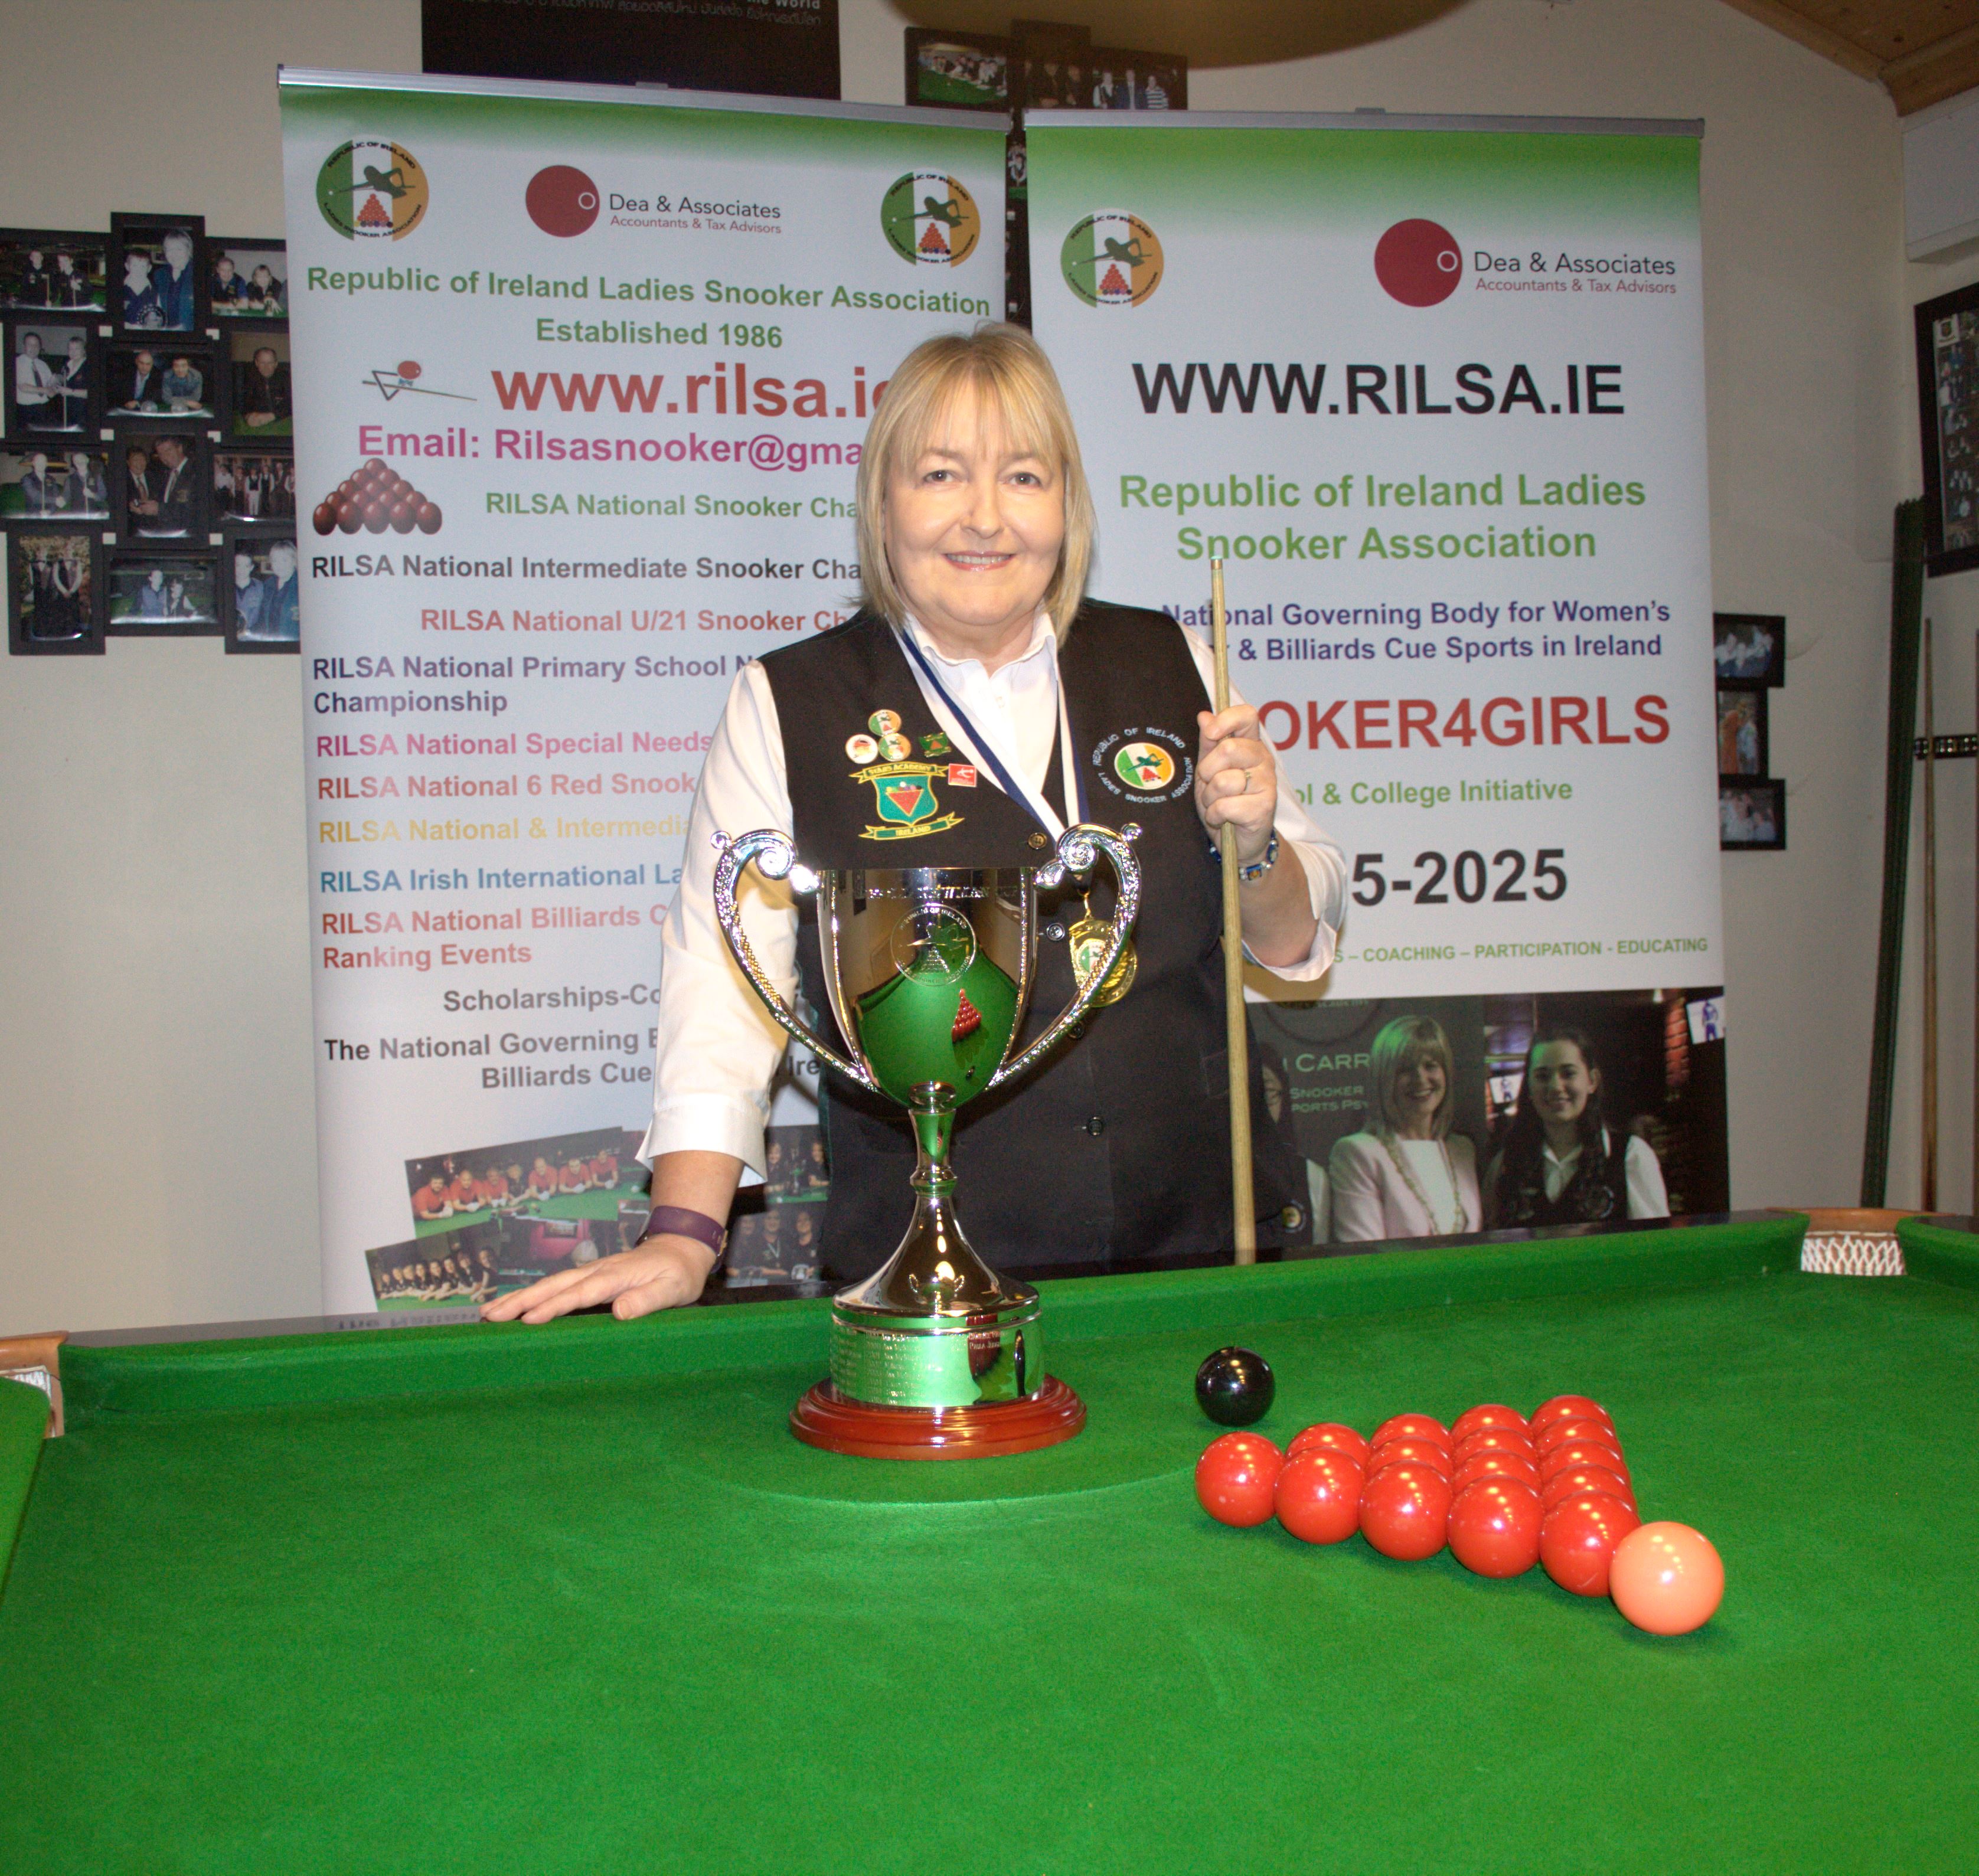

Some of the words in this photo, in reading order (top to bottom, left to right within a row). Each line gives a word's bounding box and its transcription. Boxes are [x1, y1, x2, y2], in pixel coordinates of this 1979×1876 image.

[328, 142, 365, 168] REPUBLIC
[380, 143, 416, 169] IRELAND
[938, 177, 969, 201] IRELAND
[609, 193, 649, 211] Dea
[657, 195, 671, 212] &
[678, 197, 781, 219] Associates
[383, 204, 422, 237] ASSOCIATION
[610, 215, 688, 228] Accountants
[693, 218, 702, 229] &
[706, 218, 726, 230] Tax
[729, 221, 781, 234] Advisors
[1119, 217, 1152, 238] IRELAND
[1474, 251, 1520, 272] Dea
[1530, 251, 1546, 273] &
[1555, 253, 1676, 276] Associates
[308, 267, 439, 295] Republic
[450, 271, 479, 293] of
[489, 272, 588, 299] Ireland
[600, 276, 694, 302] Ladies
[705, 280, 823, 307] Snooker
[831, 286, 990, 318] Association
[1475, 277, 1567, 292] Accountants
[1571, 279, 1583, 292] &
[1587, 278, 1612, 292] Tax
[1616, 279, 1677, 295] Advisors
[537, 318, 707, 345] Established
[719, 323, 782, 348] 1986
[1132, 363, 1624, 414] WWW.RILSA.IE
[359, 426, 479, 457] Email:
[486, 492, 569, 515] RILSA
[577, 494, 685, 515] National
[695, 495, 802, 517] Snooker
[1121, 474, 1301, 515] Republic
[1314, 475, 1353, 507] of
[1366, 473, 1503, 506] Ireland
[1518, 473, 1645, 506] Ladies
[1176, 527, 1348, 560] Snooker
[1359, 525, 1596, 559] Association
[312, 555, 393, 579] RILSA
[403, 555, 512, 577] National
[522, 557, 687, 579] Intermediate
[697, 557, 804, 579] Snooker
[422, 609, 505, 631] RILSA
[513, 610, 621, 632] National
[631, 610, 685, 631] U/21
[698, 610, 806, 631] Snooker
[1282, 603, 1421, 630] Governing
[1431, 602, 1500, 629] Body
[1508, 601, 1545, 622] for
[1553, 600, 1670, 622] Women’s
[1239, 639, 1256, 661] &
[1267, 638, 1375, 660] Billiards
[1385, 638, 1436, 659] Cue
[1446, 636, 1533, 663] Sports
[1543, 635, 1565, 656] in
[1575, 634, 1661, 656] Ireland
[313, 657, 394, 680] RILSA
[404, 656, 512, 678] National
[522, 656, 625, 682] Primary
[635, 655, 726, 677] School
[313, 691, 507, 716] Championship
[316, 735, 396, 758] RILSA
[407, 733, 516, 755] National
[526, 732, 623, 759] Special
[632, 731, 713, 753] Needs
[1093, 734, 1119, 766] REPUBLIC
[1124, 728, 1138, 736] OF
[1146, 727, 1186, 749] IRELAND
[317, 777, 400, 800] RILSA
[408, 775, 517, 797] National
[527, 775, 541, 796] 6
[551, 773, 602, 795] Red
[612, 772, 695, 794] Snook
[1098, 772, 1121, 795] LADIES
[1125, 793, 1167, 803] SNOOKER
[1171, 757, 1193, 798] ASSOCIATION
[1323, 784, 1341, 805] &
[1350, 782, 1451, 809] College
[1460, 782, 1573, 802] Initiative
[320, 821, 401, 843] RILSA
[409, 818, 519, 841] National
[528, 817, 547, 839] &
[896, 825, 931, 836] IRELAND
[321, 870, 401, 894] RILSA
[410, 868, 468, 890] Irish
[478, 864, 645, 889] International
[321, 913, 401, 935] RILSA
[412, 908, 521, 932] National
[531, 906, 641, 929] Billiards
[322, 946, 430, 971] Ranking
[441, 943, 532, 965] Events
[1363, 945, 1456, 962] COACHING
[1475, 941, 1602, 958] PARTICIPATION
[1617, 938, 1708, 953] EDUCATING
[324, 1039, 369, 1061] The
[380, 1034, 490, 1059] National
[499, 1029, 639, 1055] Governing
[482, 1064, 591, 1089] Billiards
[600, 1063, 651, 1083] Cue
[1290, 1086, 1364, 1099] SNOOKER
